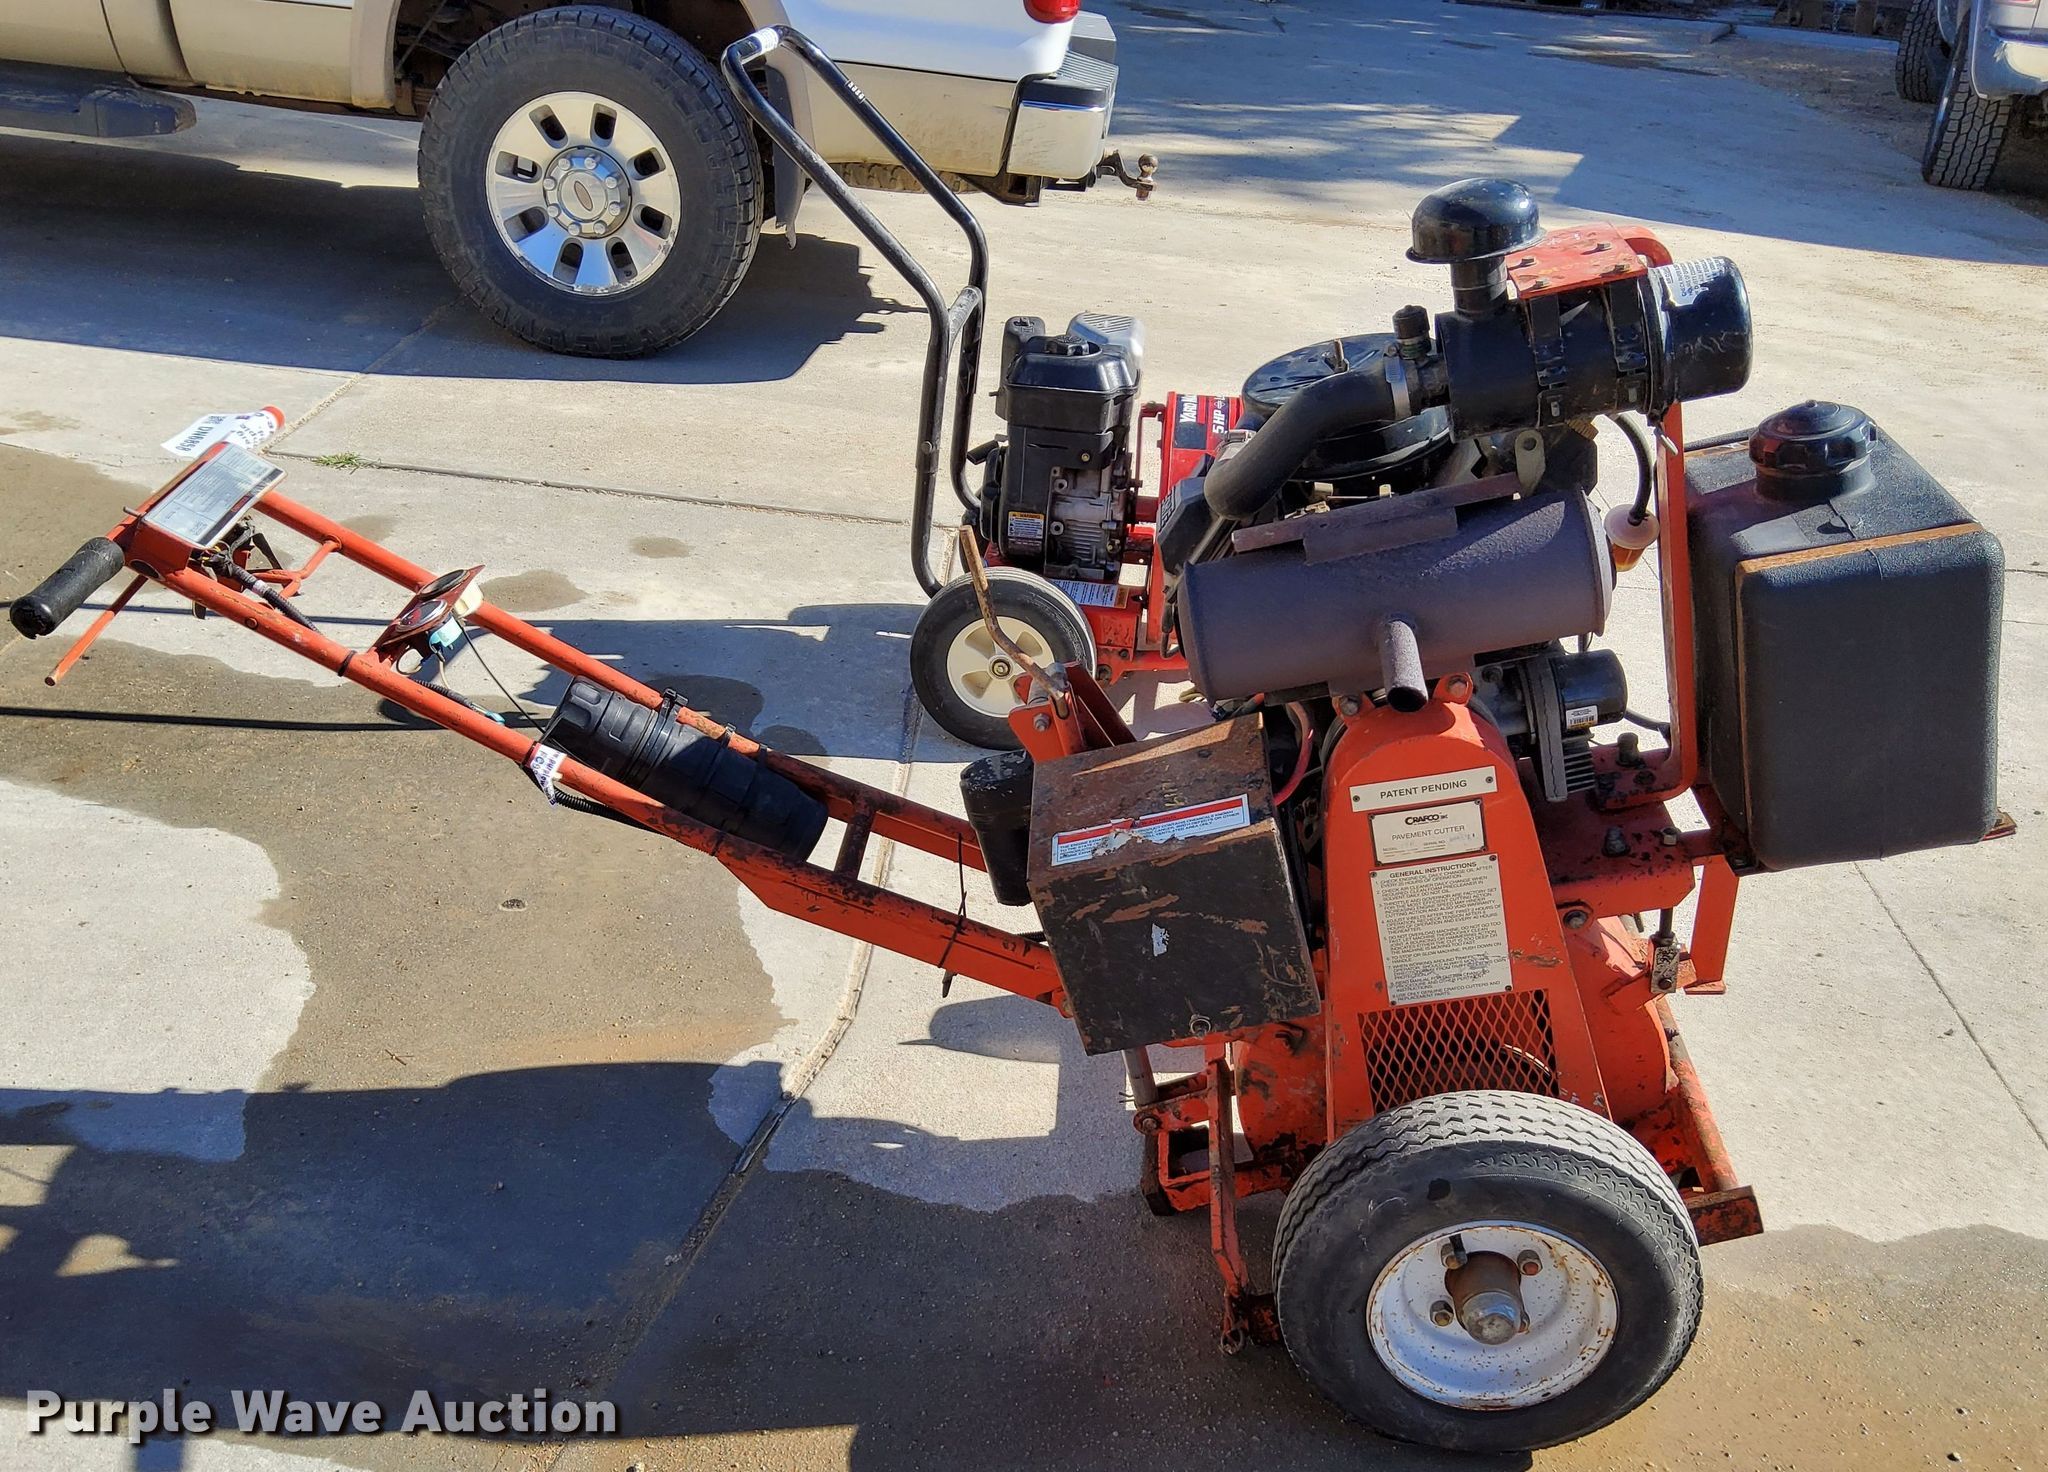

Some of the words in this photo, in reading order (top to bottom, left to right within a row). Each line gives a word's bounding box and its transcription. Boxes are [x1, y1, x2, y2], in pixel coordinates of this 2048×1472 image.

[1380, 787, 1418, 799] PATENT
[1421, 780, 1467, 794] PENDING
[1405, 813, 1440, 825] CRAFCO
[1392, 829, 1432, 841] PAVEMENT
[1433, 825, 1465, 836] CUTTER
[1389, 868, 1423, 878] GENERAL
[1424, 861, 1476, 873] INSTRUCTIONS
